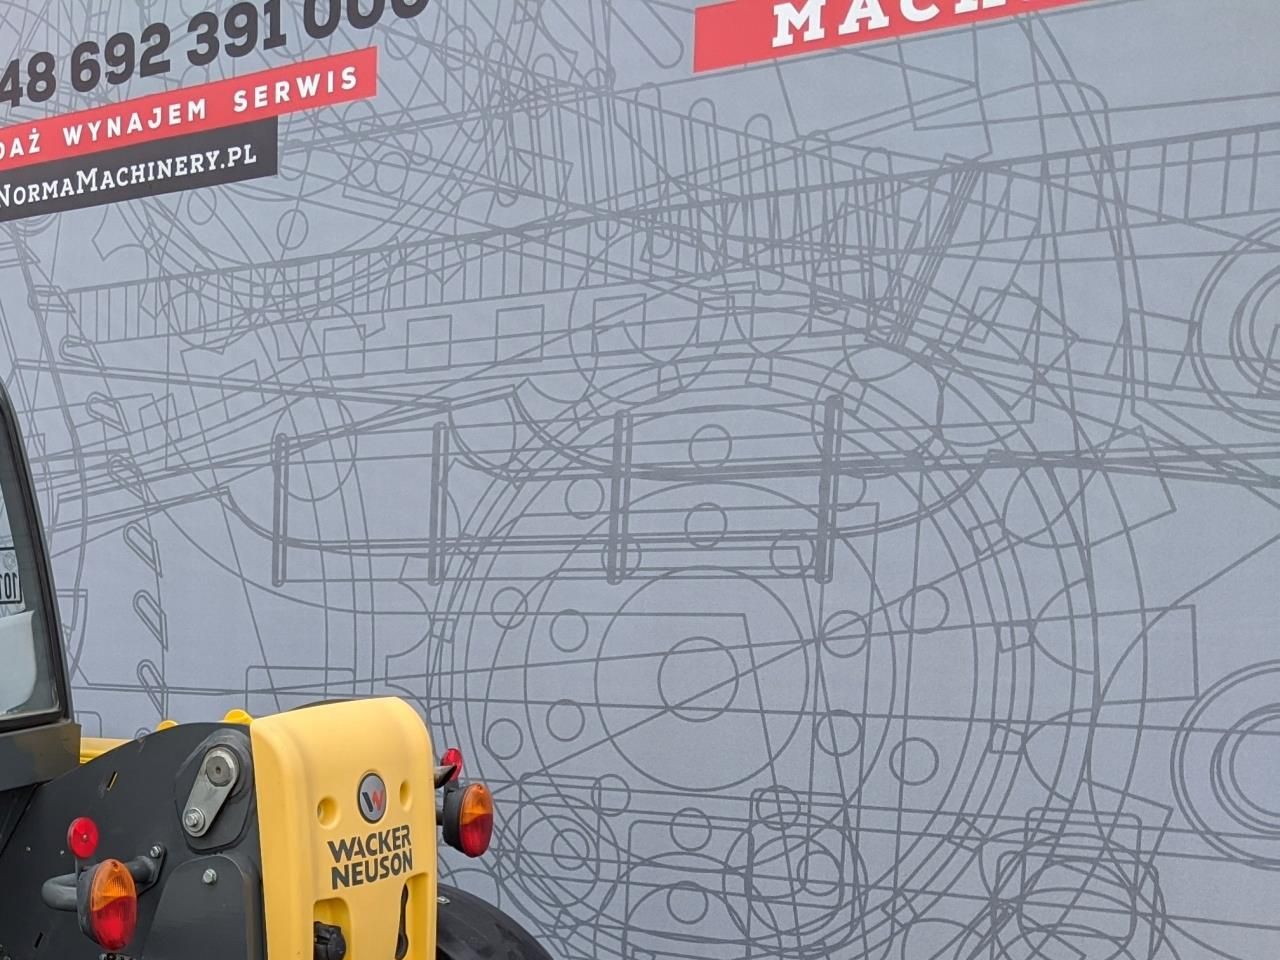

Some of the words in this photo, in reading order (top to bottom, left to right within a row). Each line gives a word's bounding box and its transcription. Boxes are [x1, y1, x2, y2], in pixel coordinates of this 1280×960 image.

[71, 22, 171, 93] 692
[187, 1, 287, 66] 391
[63, 98, 206, 146] WYNAJEM
[233, 66, 357, 112] SERWIS
[327, 824, 412, 864] WACKER
[331, 847, 413, 891] NEUSON
